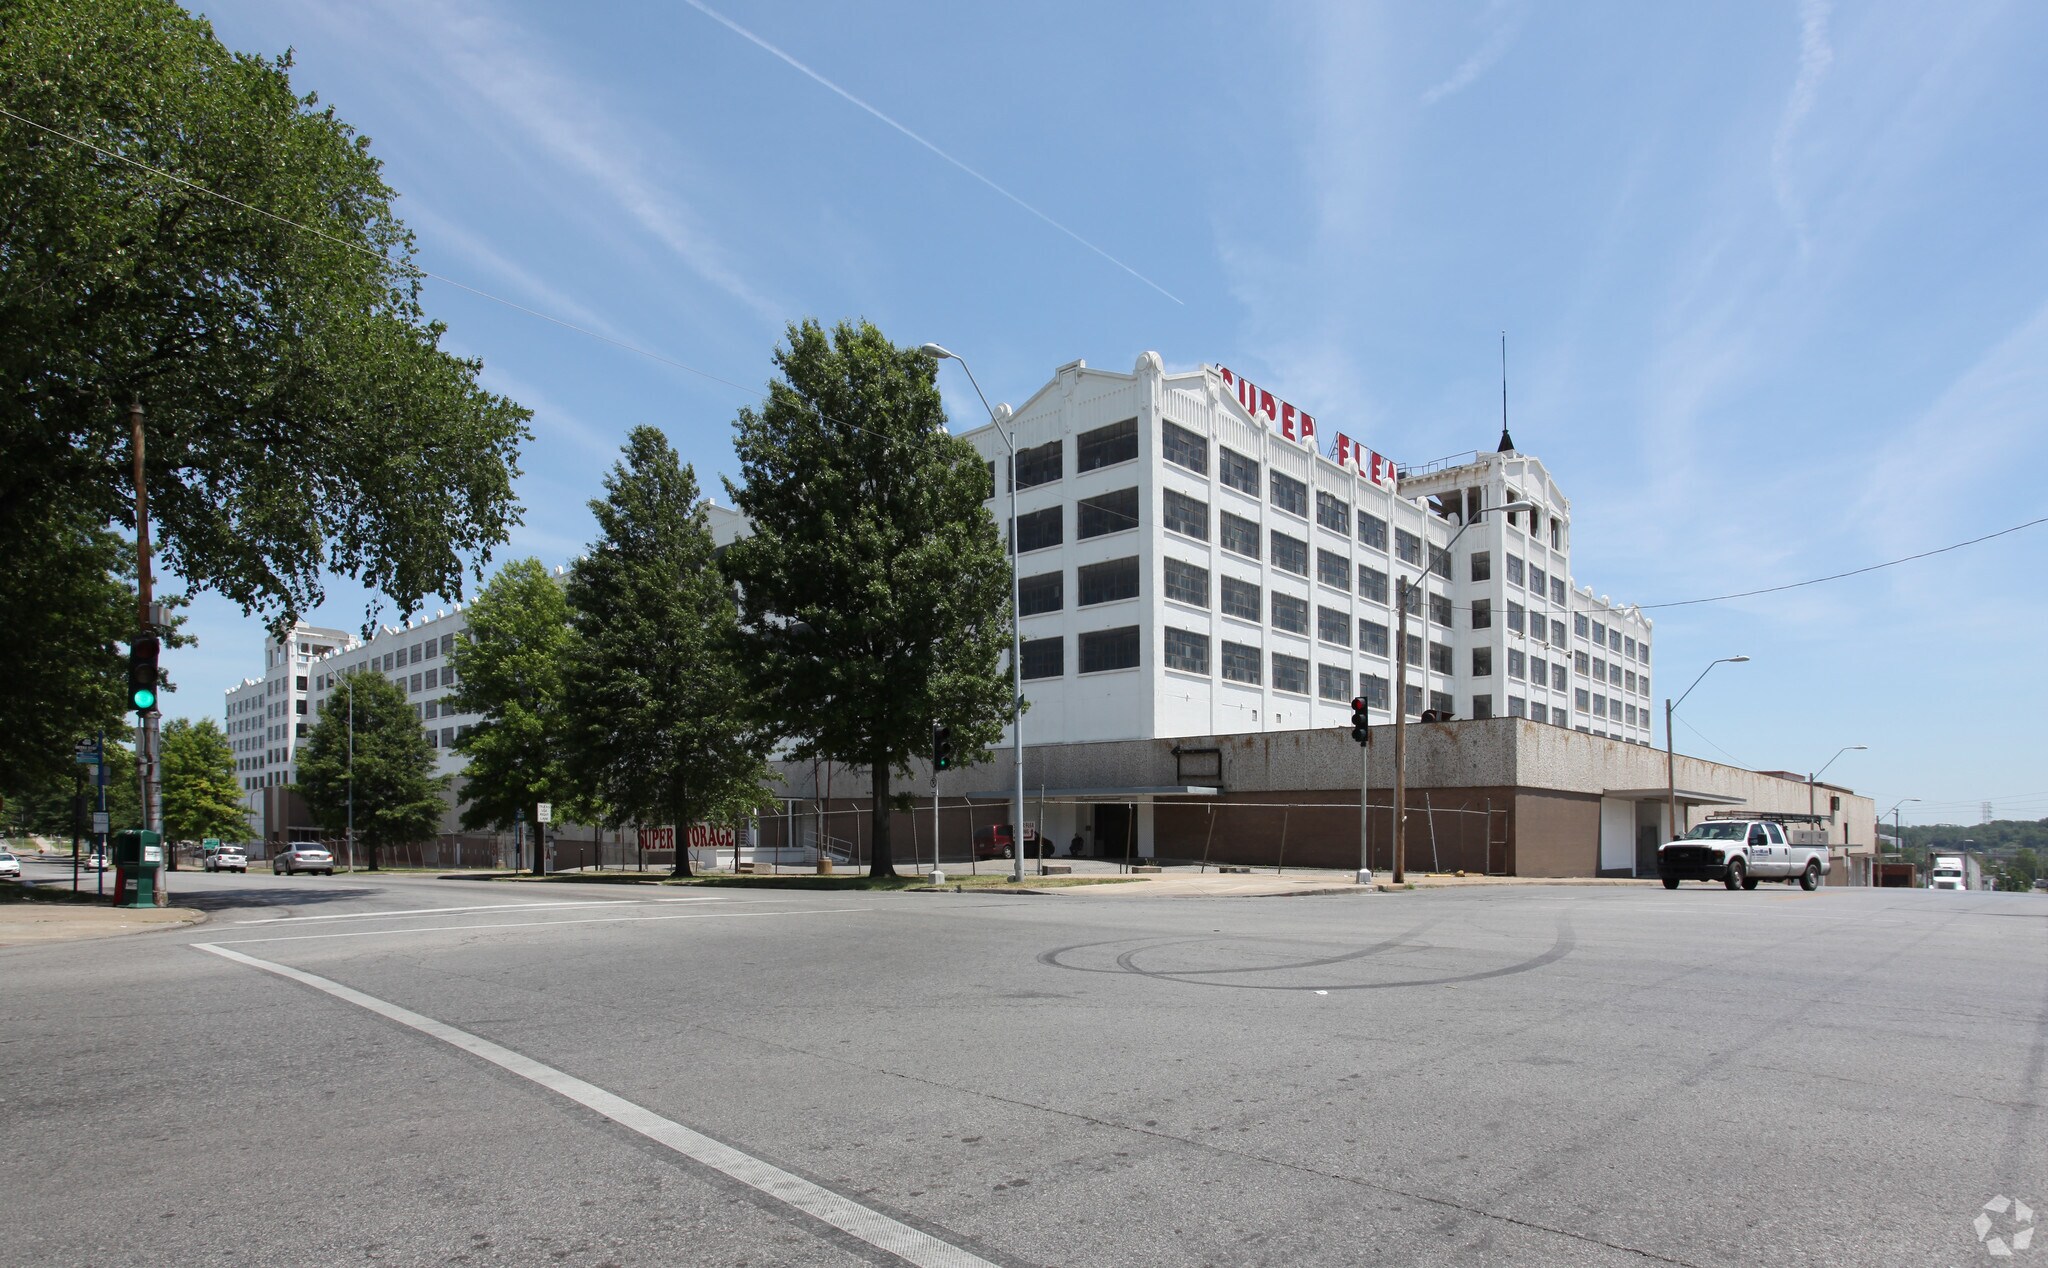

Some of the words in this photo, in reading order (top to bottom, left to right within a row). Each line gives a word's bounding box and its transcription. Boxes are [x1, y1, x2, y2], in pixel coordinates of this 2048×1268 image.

[1220, 367, 1314, 442] SUPER
[1338, 432, 1396, 486] FLEA
[639, 827, 674, 850] SUPER
[687, 824, 734, 848] TORAGE
